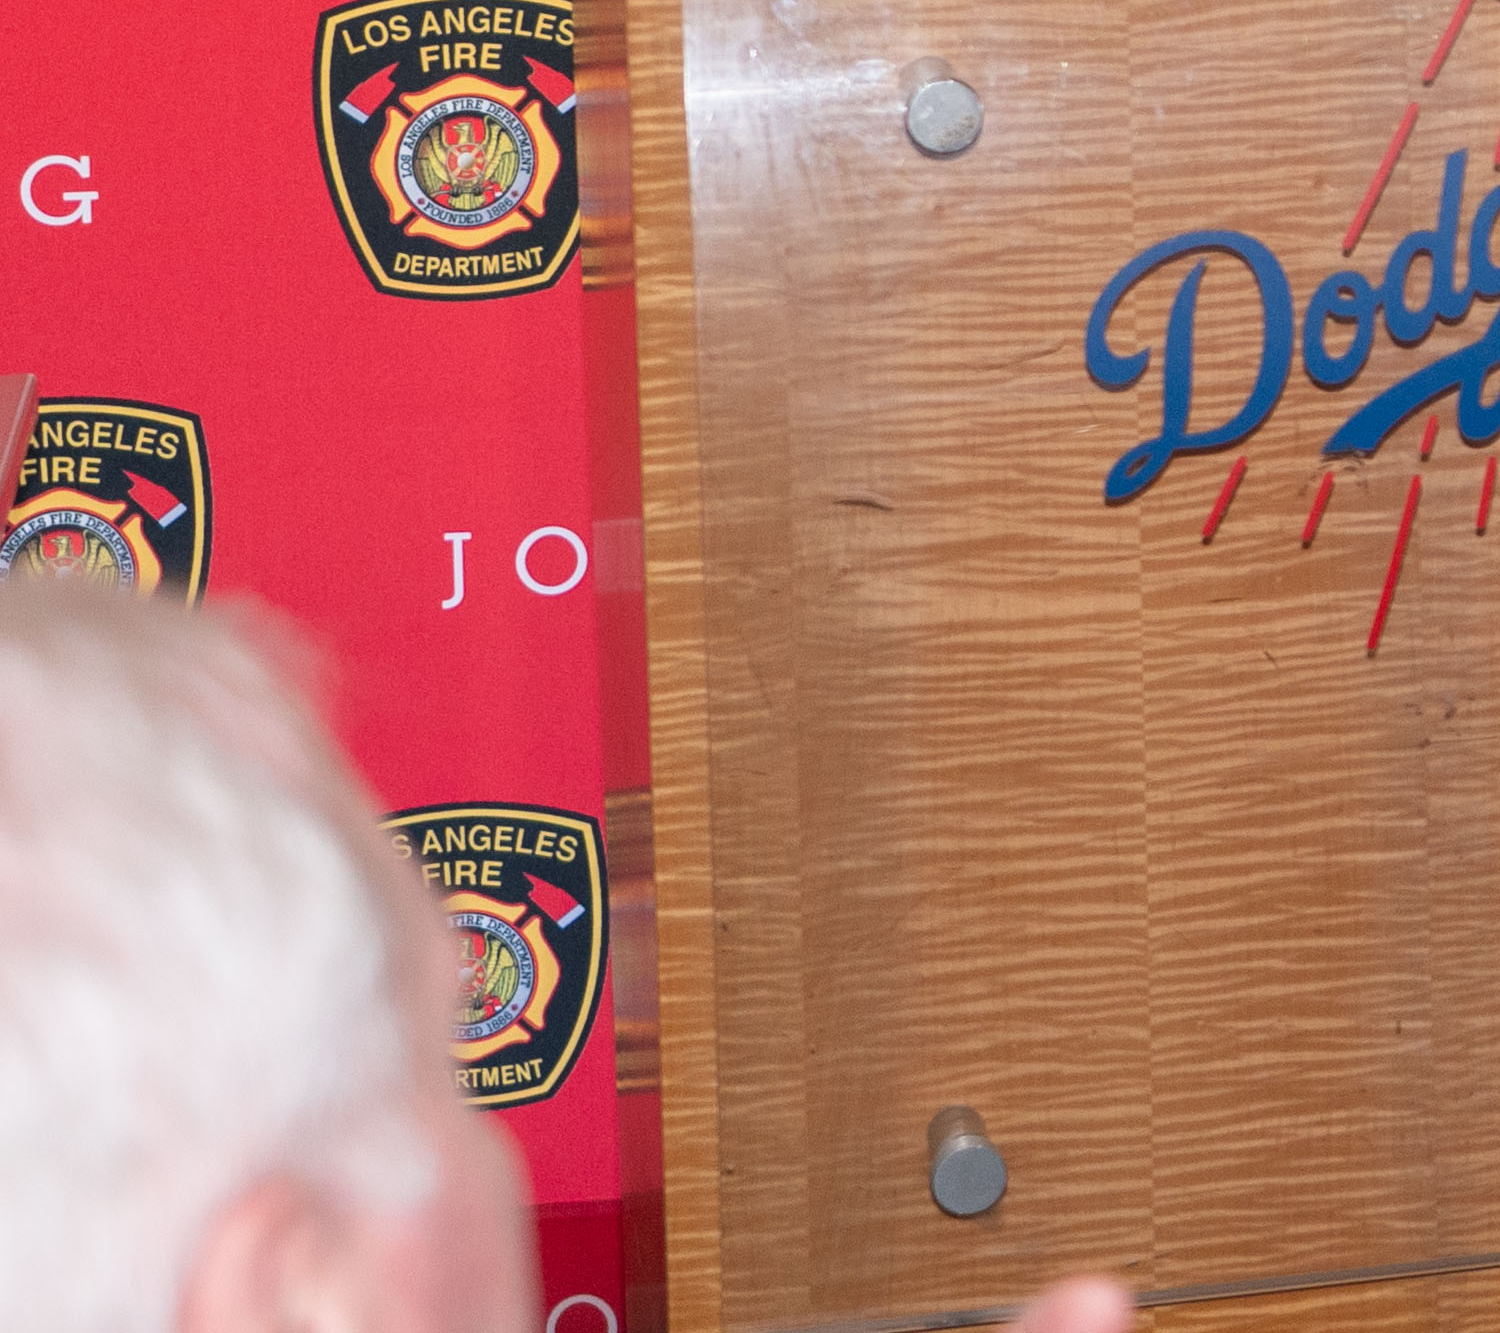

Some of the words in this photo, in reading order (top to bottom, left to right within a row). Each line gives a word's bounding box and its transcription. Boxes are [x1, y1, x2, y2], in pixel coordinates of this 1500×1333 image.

[342, 15, 412, 55] LOS
[420, 6, 574, 46] ANGELES
[419, 42, 503, 73] FIRE
[405, 105, 449, 149] ANGELES
[452, 98, 484, 111] FIRE
[486, 103, 534, 174] DEPARTMENT
[424, 202, 484, 224] FOUNDED
[394, 246, 544, 277] DEPARTMENT
[19, 456, 102, 485] FIRE
[421, 824, 579, 863] ANGELES
[422, 860, 504, 887] FIRE
[456, 1058, 544, 1088] RTMENT
